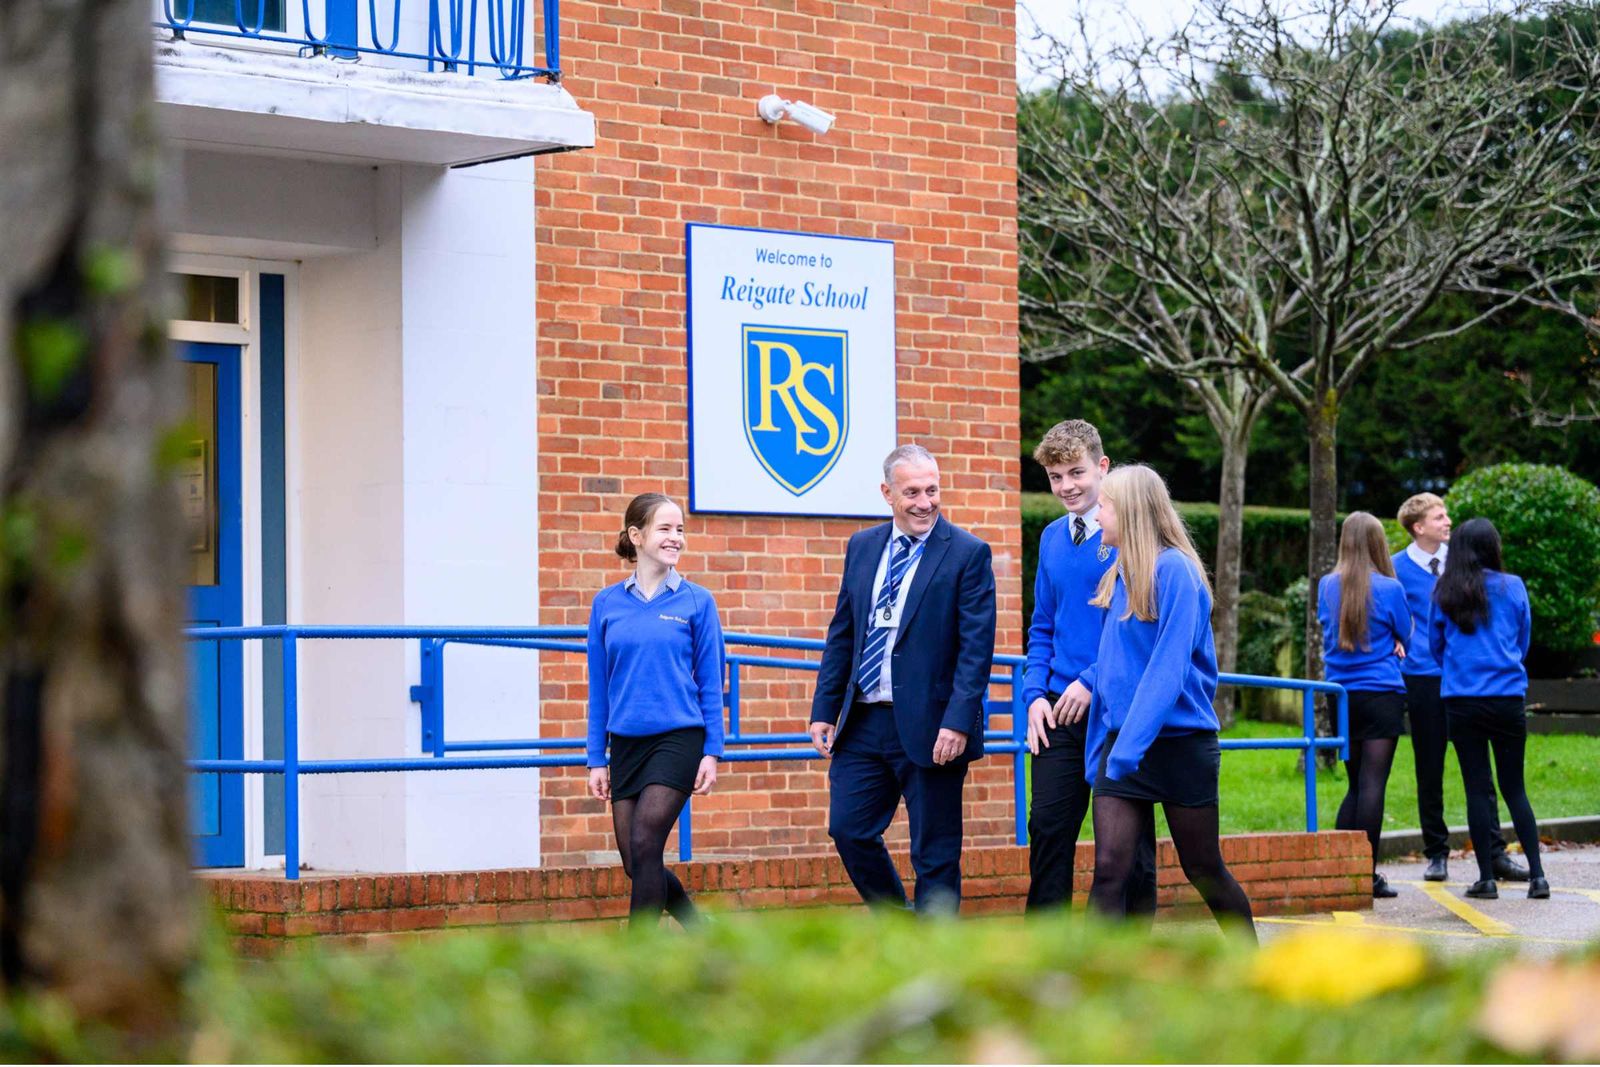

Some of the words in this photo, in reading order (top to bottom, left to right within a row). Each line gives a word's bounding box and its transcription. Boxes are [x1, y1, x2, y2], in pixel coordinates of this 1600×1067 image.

[756, 247, 817, 268] Welcome
[820, 253, 833, 268] to
[721, 275, 795, 310] Reigate
[800, 281, 868, 310] School
[750, 340, 840, 456] RS
